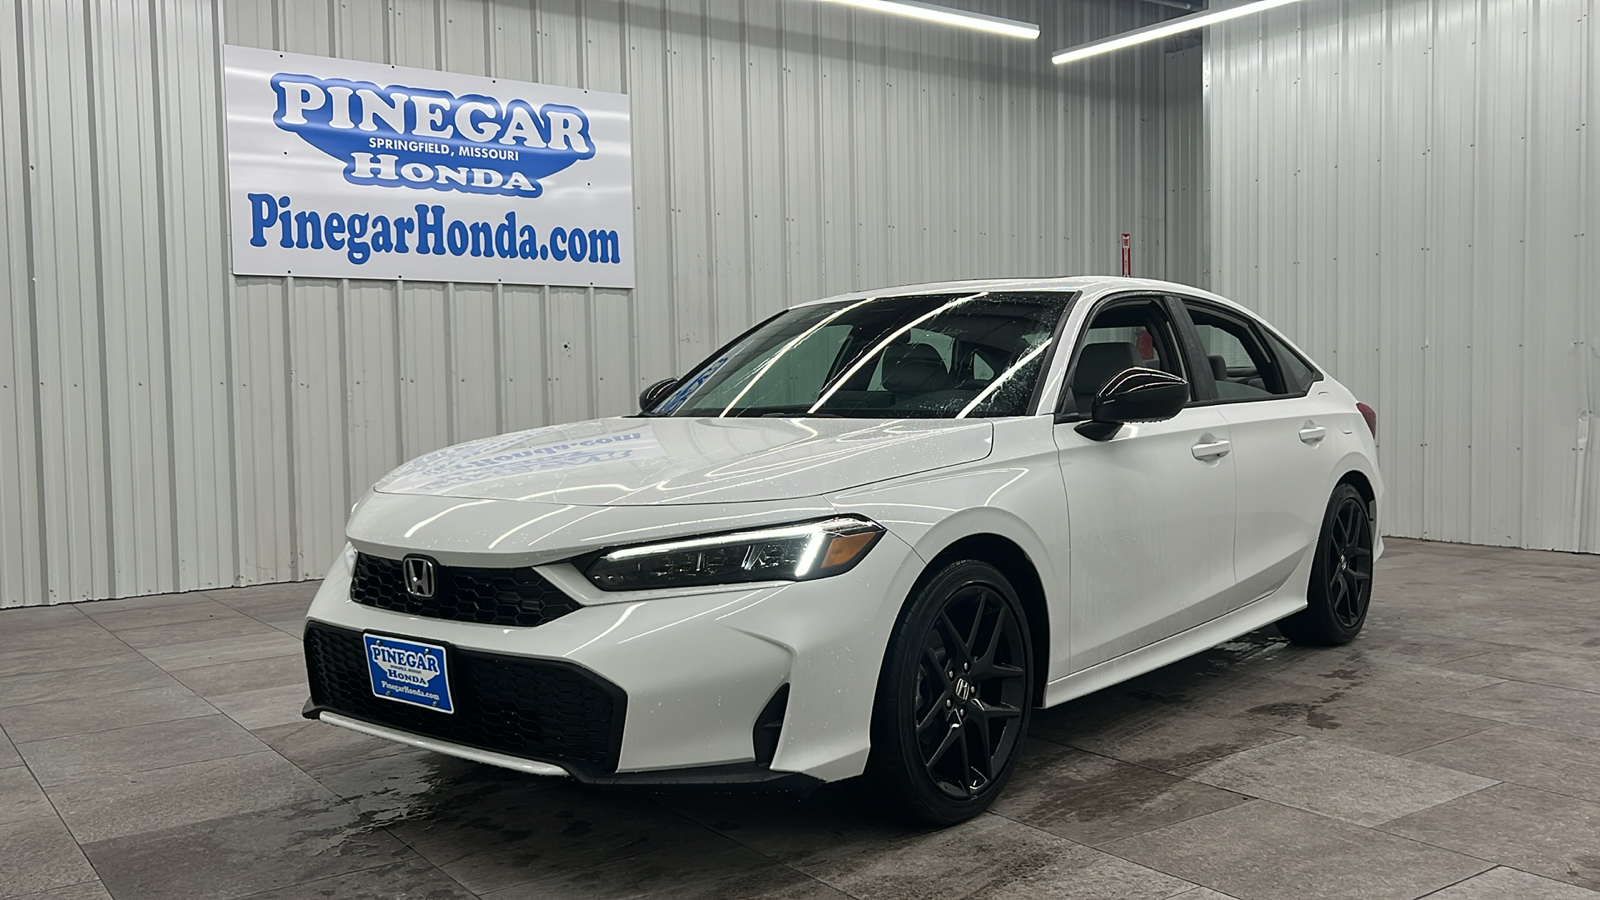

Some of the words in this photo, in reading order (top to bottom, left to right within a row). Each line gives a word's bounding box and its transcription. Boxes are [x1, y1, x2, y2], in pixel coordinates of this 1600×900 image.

[277, 80, 591, 154] PINEGAR
[368, 137, 455, 157] SPRINGFIELD,
[459, 145, 519, 161] MISSOURI
[350, 152, 537, 191] HONDA
[247, 193, 621, 265] PinegarHonda.com
[372, 646, 439, 673] PINEGAR
[381, 680, 440, 701] PinegarHonda.com
[387, 668, 427, 686] HONDA
